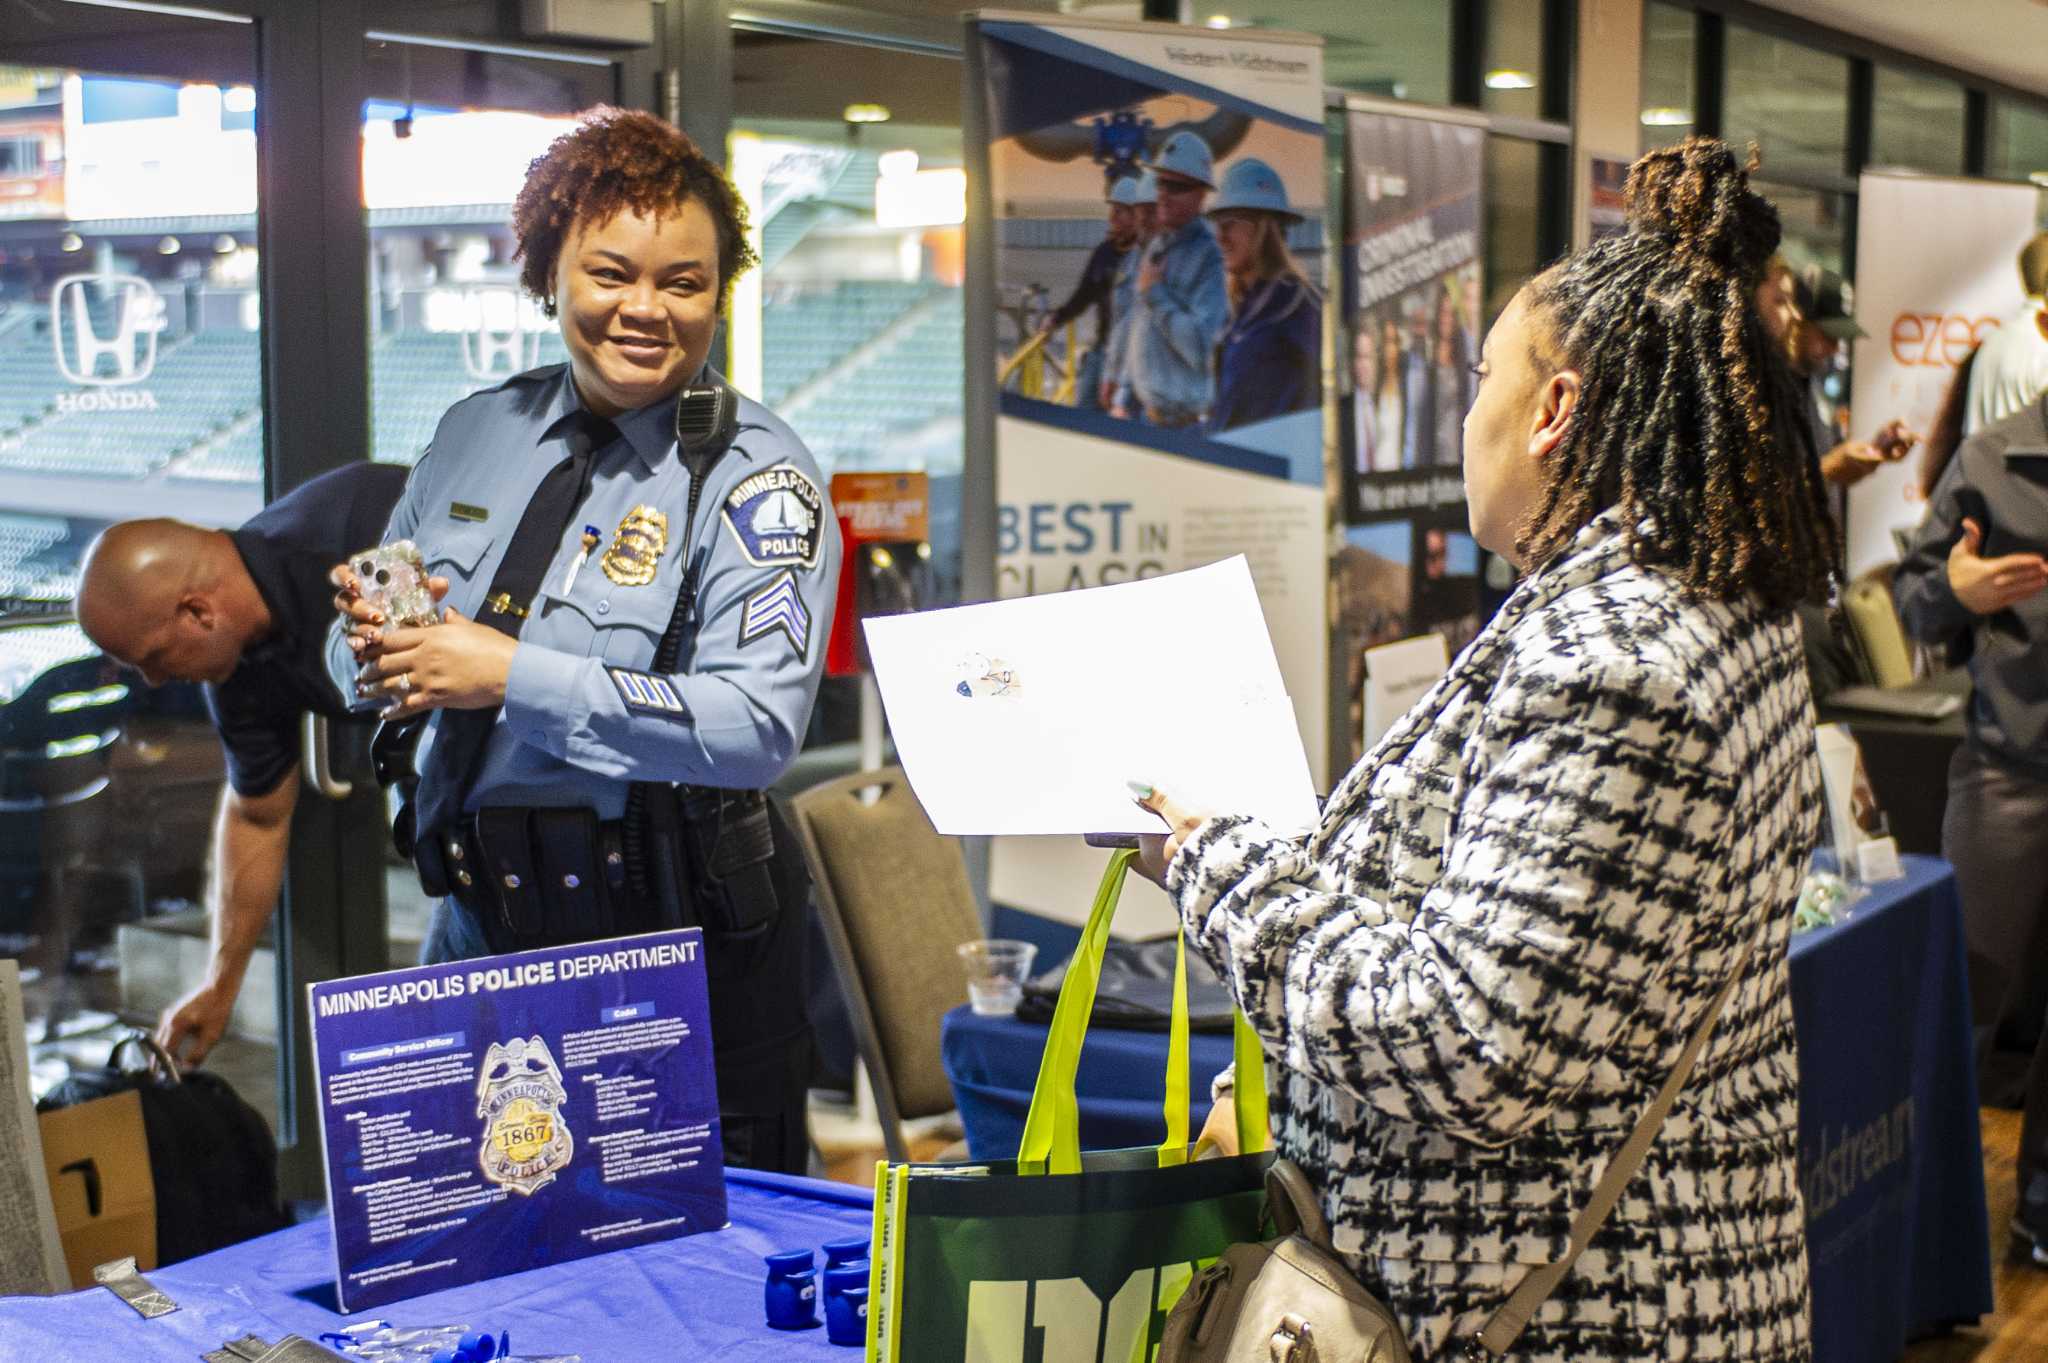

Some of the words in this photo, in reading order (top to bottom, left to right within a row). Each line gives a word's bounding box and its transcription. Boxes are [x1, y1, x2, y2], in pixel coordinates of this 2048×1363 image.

[55, 388, 159, 412] HONDA
[727, 470, 819, 510] MINNEAPOLIS
[997, 503, 1132, 554] BEST
[1137, 524, 1169, 551] IN
[760, 537, 811, 558] POLICE
[319, 974, 465, 1018] MINNEAPOLIS
[468, 961, 556, 995] POLICE
[559, 940, 699, 981] DEPARTMENT
[503, 1125, 547, 1147] 1867
